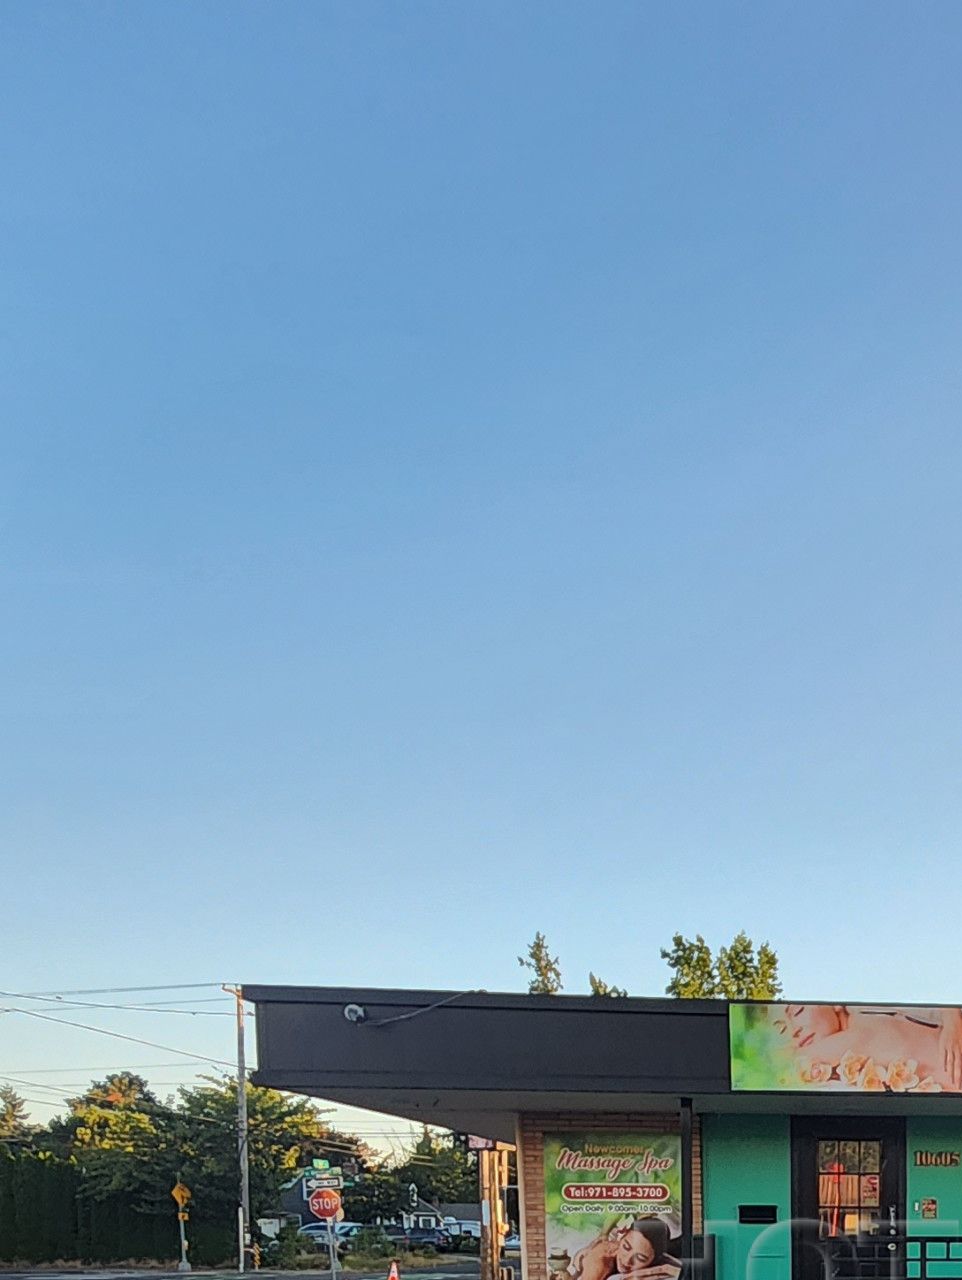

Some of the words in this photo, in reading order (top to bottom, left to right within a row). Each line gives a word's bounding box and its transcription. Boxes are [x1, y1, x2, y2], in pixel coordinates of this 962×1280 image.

[556, 1148, 633, 1180] Massage
[636, 1149, 674, 1175] Spa
[914, 1151, 961, 1167] 10605
[312, 1198, 338, 1210] STOP
[561, 1205, 584, 1214] Open
[585, 1204, 604, 1213] Daily
